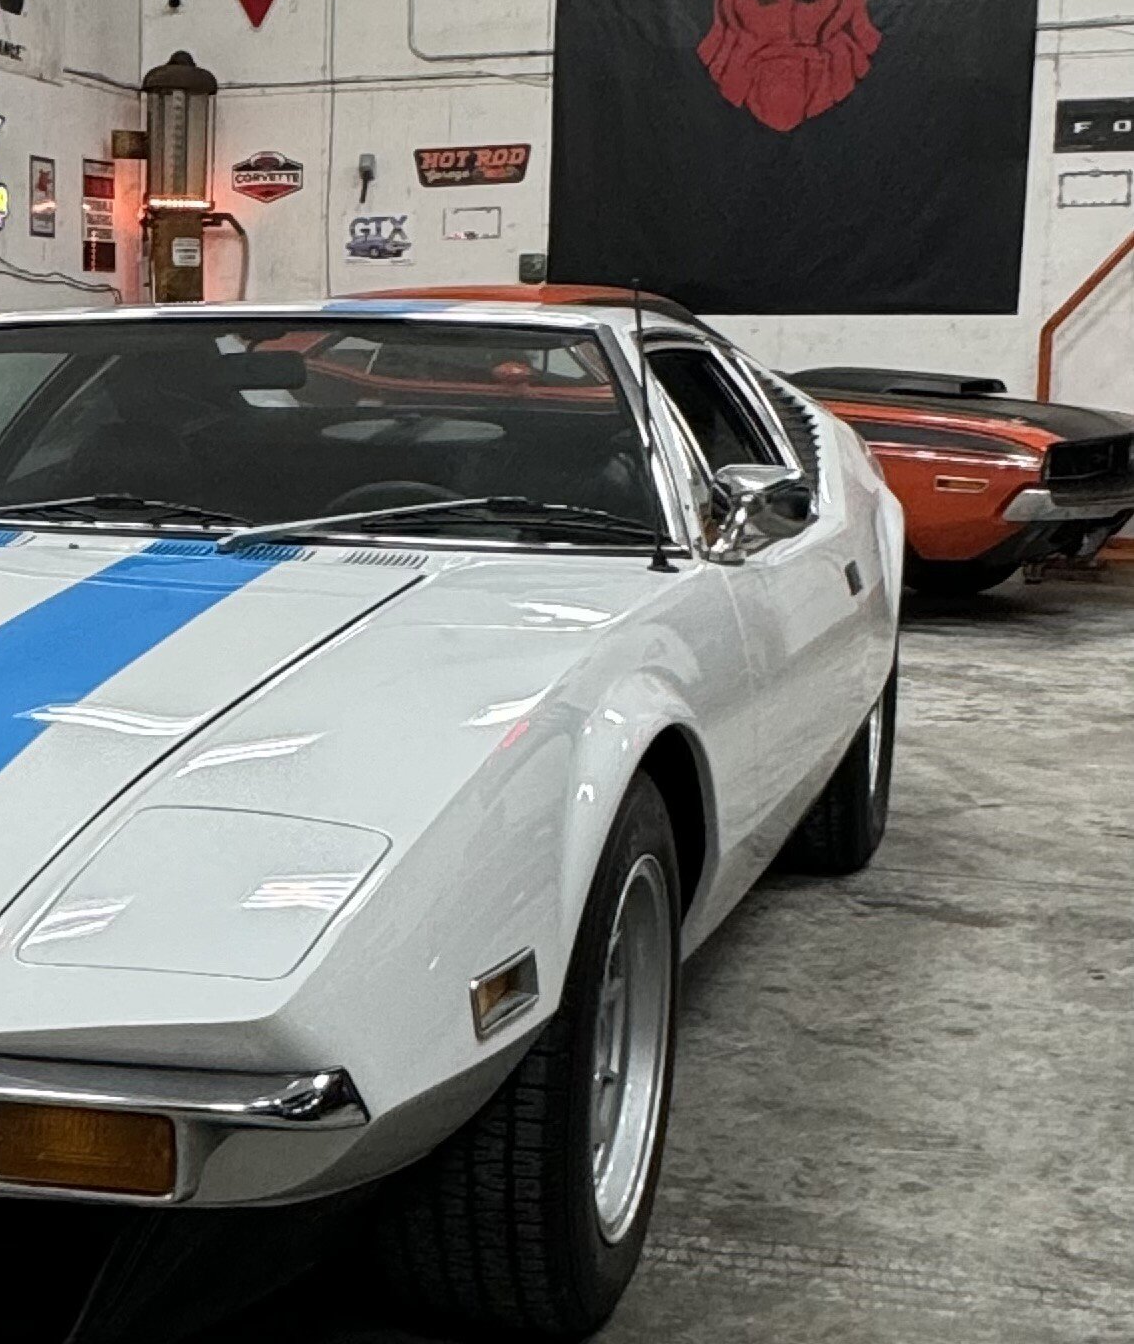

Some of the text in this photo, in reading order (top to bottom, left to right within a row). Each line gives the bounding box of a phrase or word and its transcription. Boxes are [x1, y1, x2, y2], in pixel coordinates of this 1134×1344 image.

[420, 147, 527, 170] HOT ROD
[235, 171, 299, 184] CORVETTE
[349, 214, 408, 242] GTX
